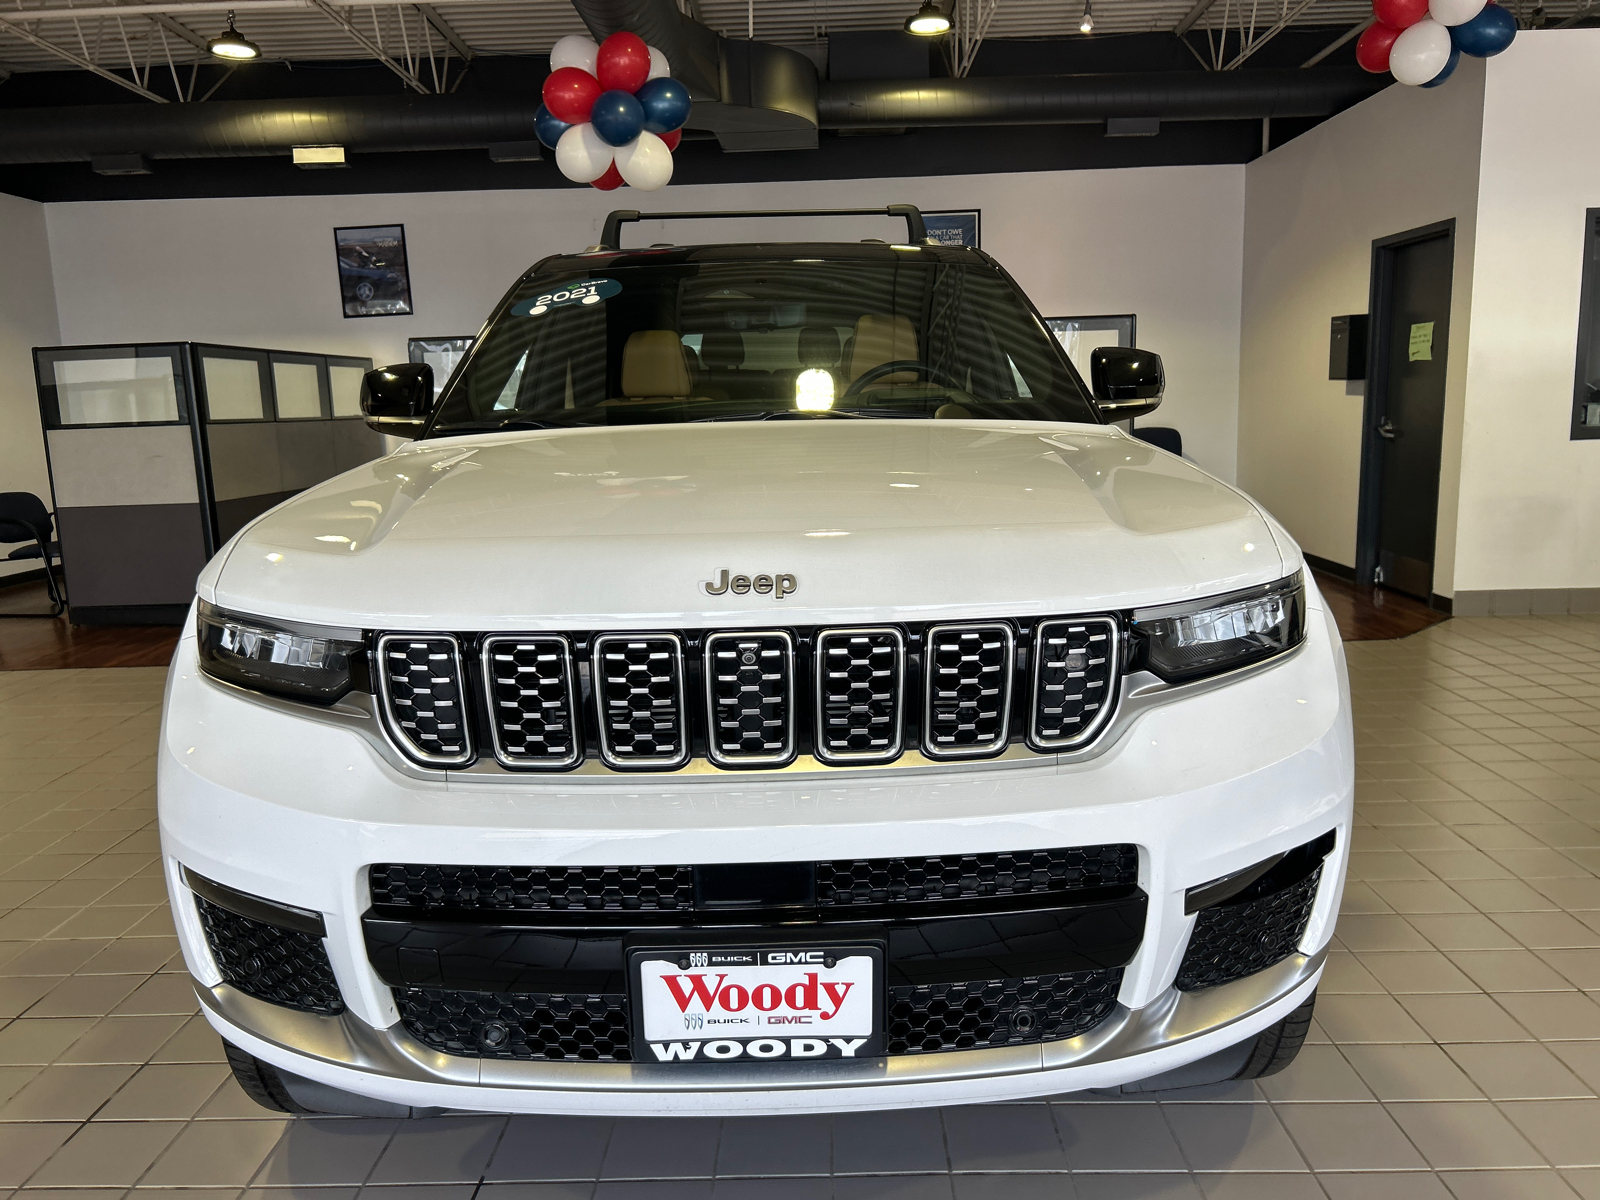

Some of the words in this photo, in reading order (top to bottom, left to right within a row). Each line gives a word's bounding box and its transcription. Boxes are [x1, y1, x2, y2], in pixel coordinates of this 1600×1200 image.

[536, 286, 598, 306] 2021
[705, 569, 798, 599] Jeep
[711, 955, 753, 963] BUICK
[767, 951, 824, 964] GMC
[659, 972, 855, 1021] Woody
[706, 1017, 750, 1025] BUICK
[767, 1015, 813, 1025] GMC
[649, 1038, 868, 1061] WOODY
